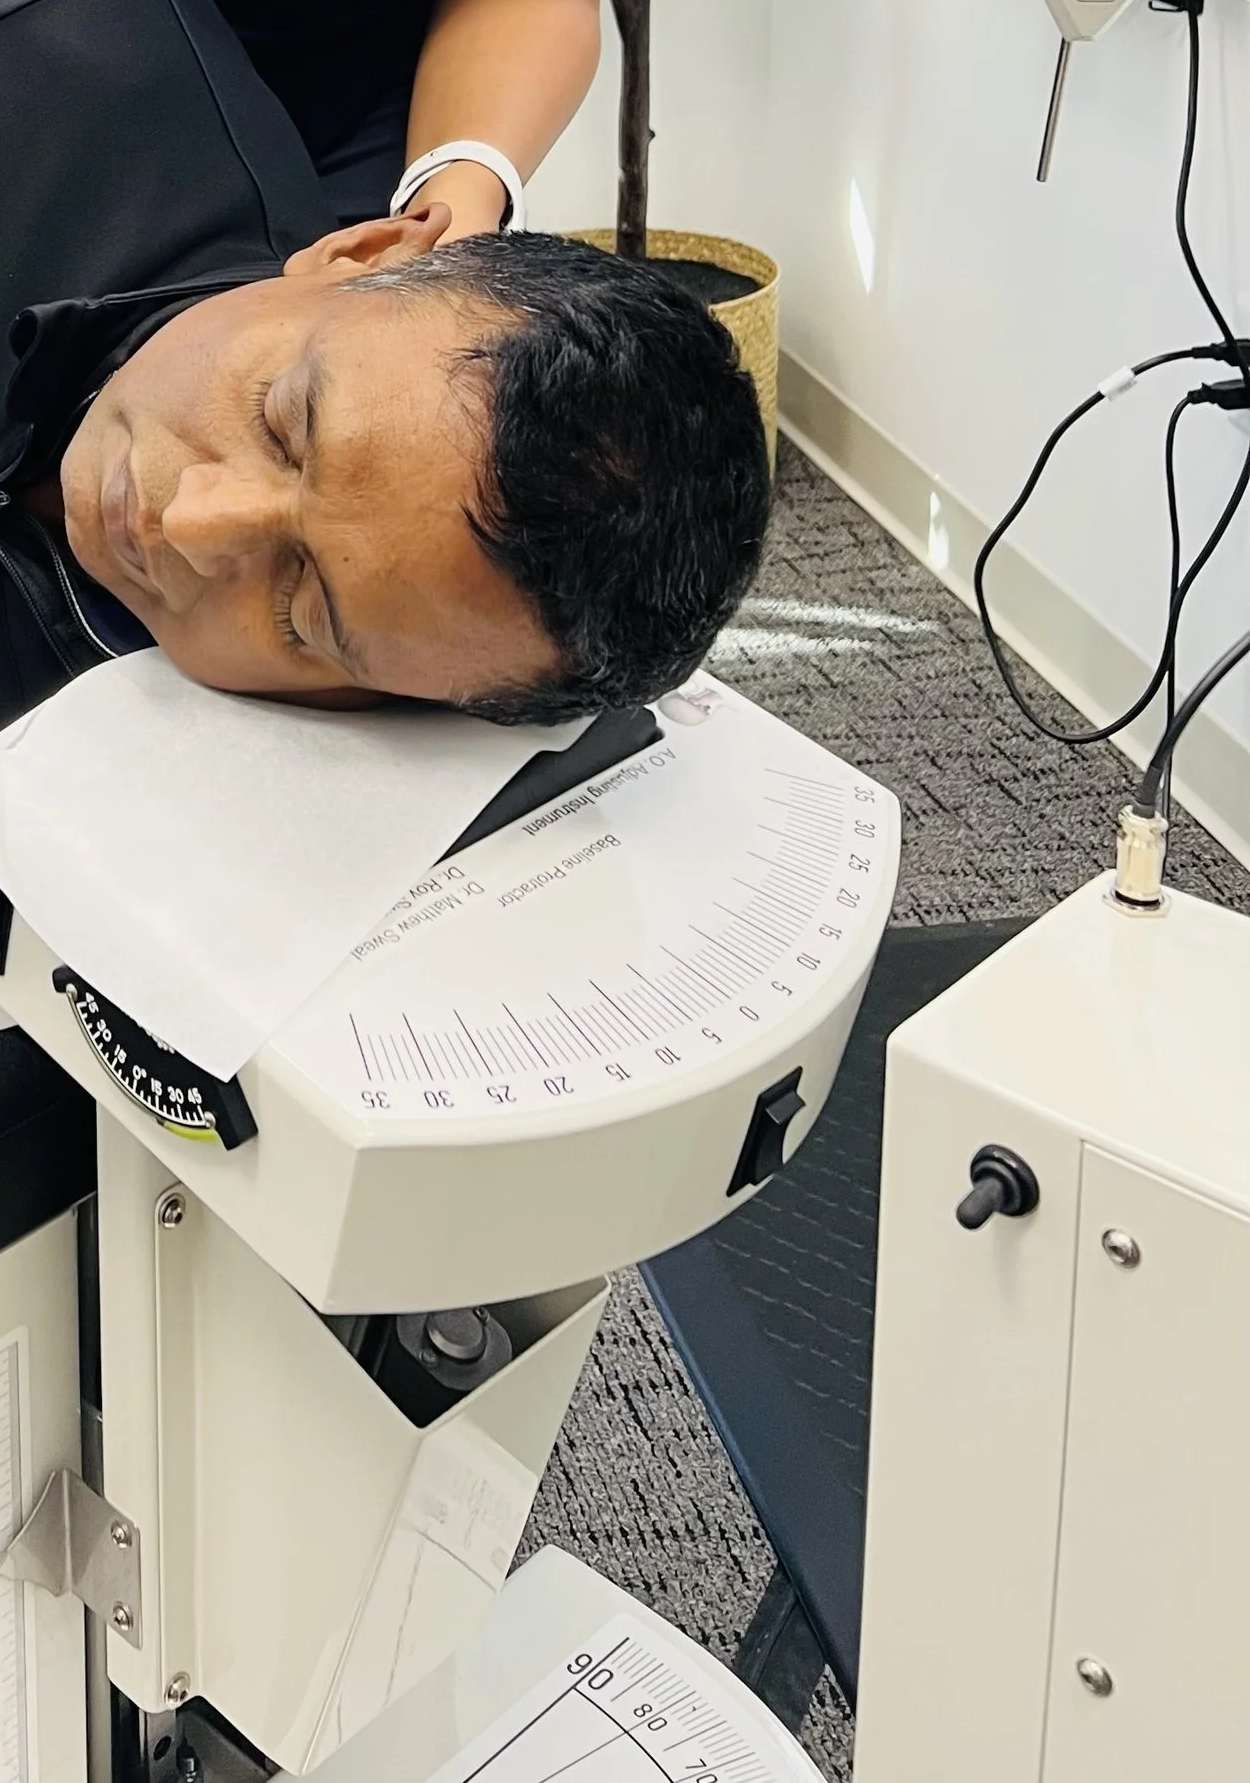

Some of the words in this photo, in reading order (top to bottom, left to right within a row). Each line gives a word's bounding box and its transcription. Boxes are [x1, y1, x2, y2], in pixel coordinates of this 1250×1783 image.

[587, 766, 650, 798] Adjusting
[854, 786, 875, 803] 35
[522, 793, 596, 837] Instrument
[854, 819, 875, 838] 30
[561, 834, 622, 869] Baseline
[438, 866, 465, 880] Dr.
[848, 854, 871, 873] 25
[456, 881, 485, 896] Dr.
[497, 866, 567, 908] Protractor
[836, 888, 860, 908] 20
[398, 894, 463, 933] Matthew
[819, 923, 843, 941] 15
[796, 952, 822, 970] 10
[771, 981, 793, 996] 5
[739, 1005, 759, 1021] 0
[701, 1027, 722, 1044] 5
[114, 1044, 127, 1064] 15
[654, 1046, 681, 1066] 10
[605, 1063, 631, 1082] 15
[150, 1077, 162, 1096] 15
[167, 1085, 184, 1104] 30
[188, 1087, 202, 1104] 45
[486, 1085, 517, 1104] 25
[543, 1076, 574, 1096] 20
[361, 1090, 391, 1109] 35
[423, 1090, 454, 1109] 30
[566, 1653, 614, 1690] 90
[633, 1703, 668, 1732] 80
[686, 1758, 718, 1783] 70
